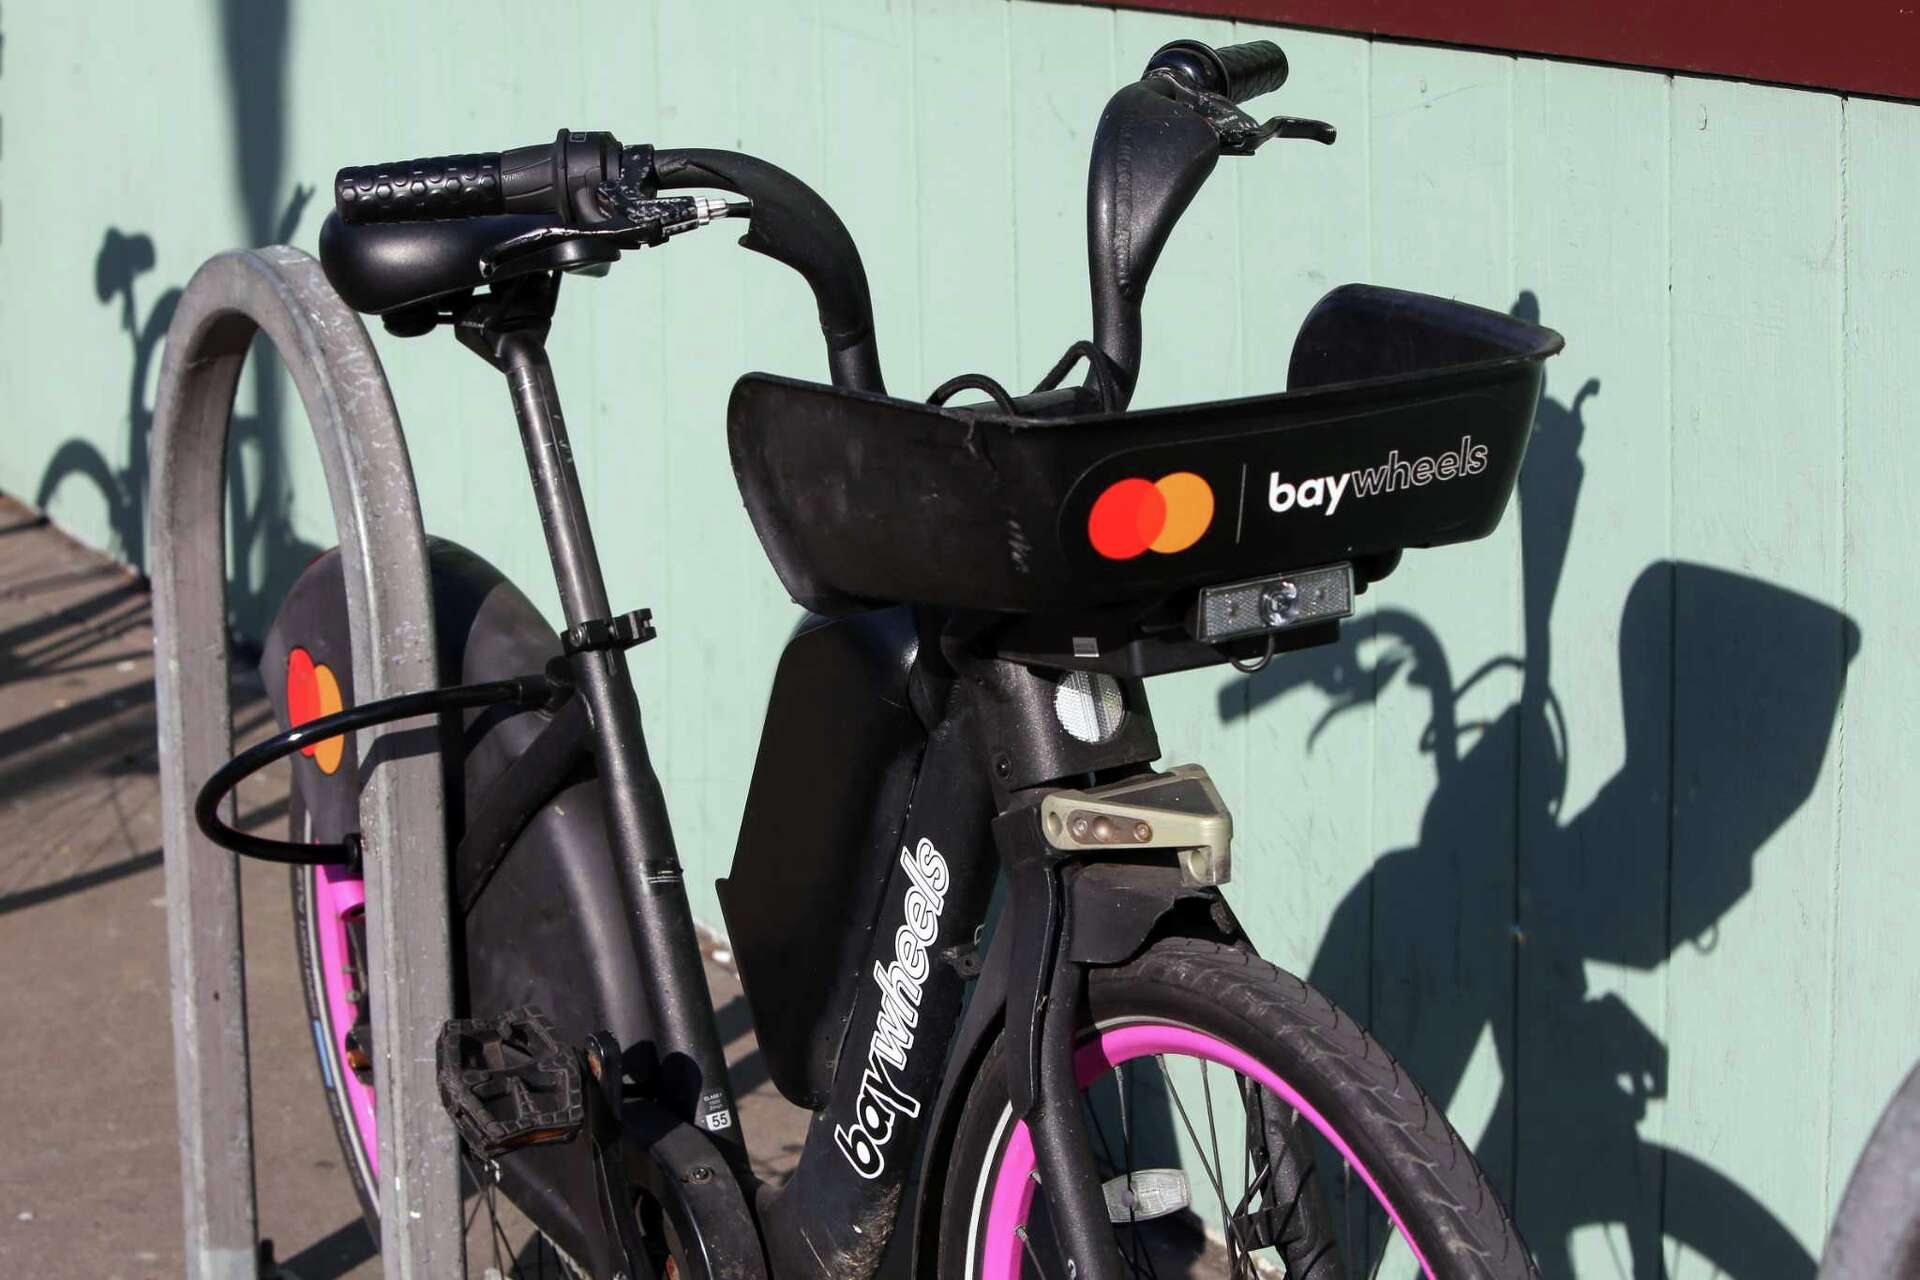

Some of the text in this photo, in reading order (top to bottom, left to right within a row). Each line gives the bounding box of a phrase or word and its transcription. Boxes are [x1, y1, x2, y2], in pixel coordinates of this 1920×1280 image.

[1268, 434, 1489, 516] baywheels
[833, 837, 950, 1180] baywheels
[711, 1112, 729, 1128] 55
